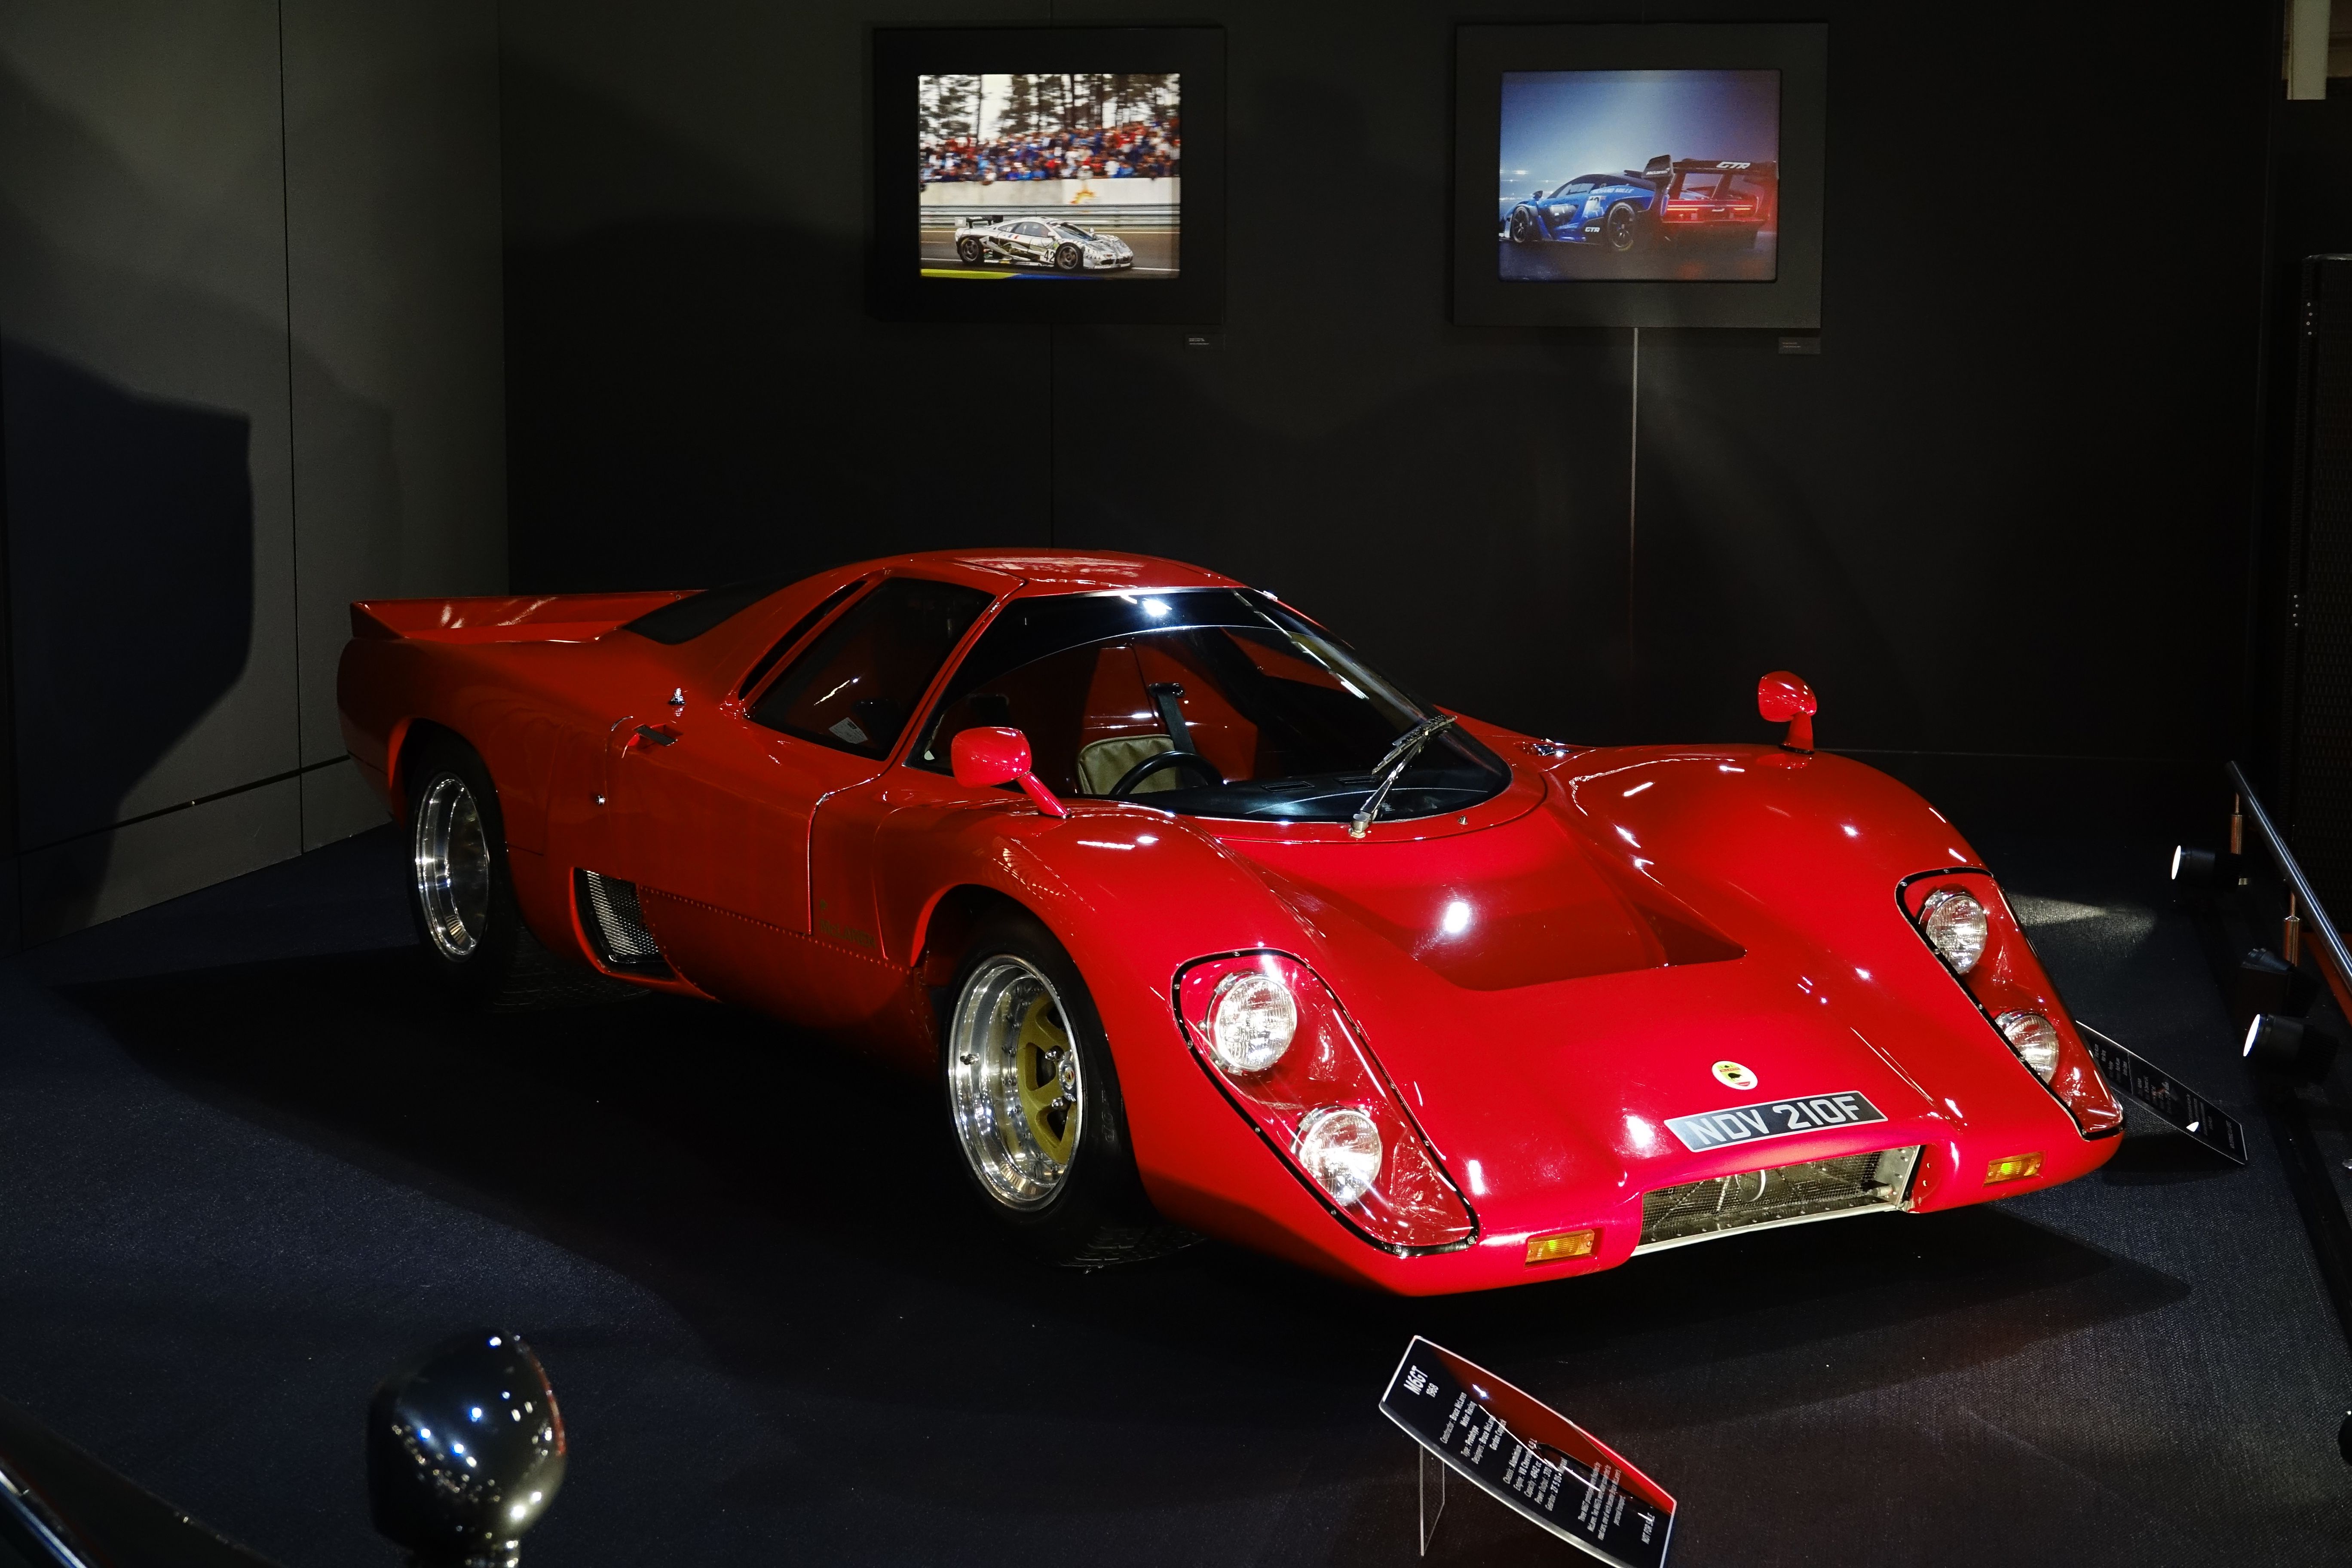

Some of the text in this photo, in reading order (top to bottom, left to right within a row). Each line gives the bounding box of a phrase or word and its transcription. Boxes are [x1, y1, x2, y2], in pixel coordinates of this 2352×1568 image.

[1716, 161, 1751, 169] GTR
[1044, 250, 1055, 263] 42
[1686, 1095, 1860, 1145] NDV 210F
[1404, 1366, 1427, 1394] M6GT
[1426, 1383, 1439, 1397] 1968
[1440, 1421, 1454, 1443] Constructor
[1449, 1408, 1460, 1421] Bruce
[1455, 1392, 1467, 1409] McLaren
[1460, 1401, 1477, 1427] Motor Racing
[1465, 1425, 1479, 1446] Prototype
[1489, 1419, 1507, 1450] Gordon Coppck
[1461, 1446, 1470, 1457] Type
[1471, 1445, 1484, 1464] Designers
[1479, 1431, 1489, 1444] Bruce
[1521, 1448, 1534, 1469] Chevrole
[1503, 1468, 1514, 1484] Chassis
[1518, 1467, 1527, 1475] V8
[1553, 1474, 1562, 1483] DS
[1513, 1476, 1524, 1491] Engine
[1524, 1480, 1536, 1498] Capacity
[1530, 1465, 1540, 1479] 4942
[1550, 1484, 1558, 1493] ZF
[1534, 1491, 1544, 1504] Power
[1643, 1524, 1652, 1535] FOR
[1642, 1532, 1650, 1544] NOT
